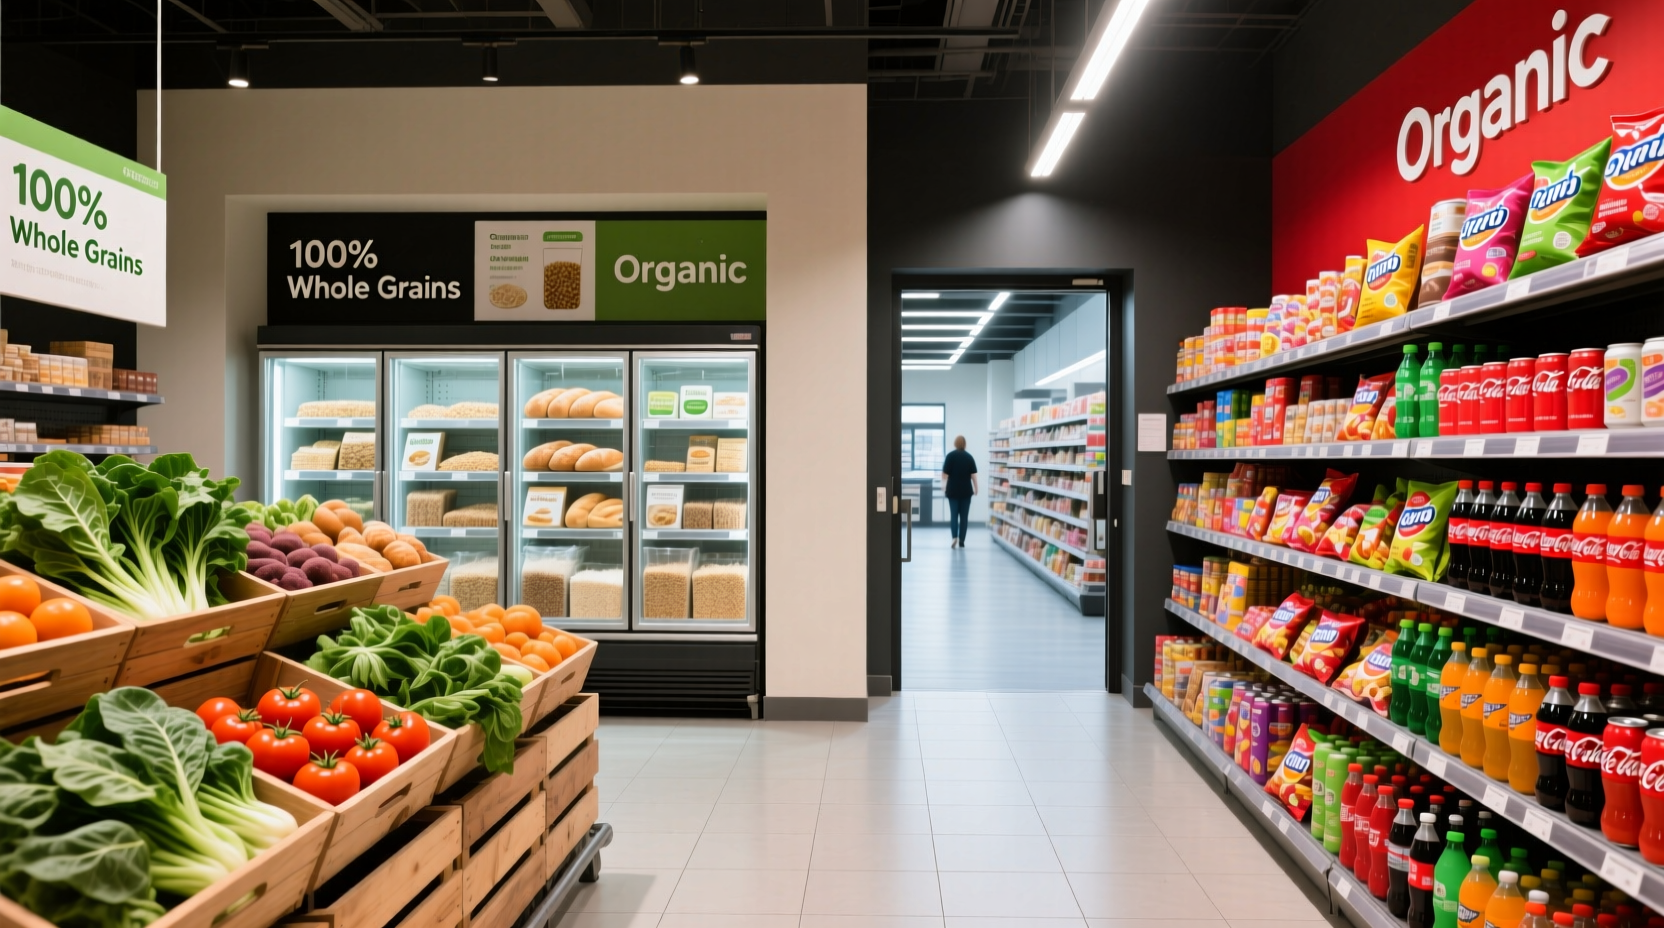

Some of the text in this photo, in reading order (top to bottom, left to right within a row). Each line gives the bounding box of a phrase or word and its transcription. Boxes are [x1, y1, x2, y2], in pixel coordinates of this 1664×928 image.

[1396, 9, 1611, 182] Organic
[12, 163, 108, 231] 100%
[9, 215, 80, 259] Whole
[84, 238, 144, 276] Grains
[289, 239, 379, 269] 100%
[287, 274, 461, 299] Whole Grains
[614, 253, 747, 292] Organic
